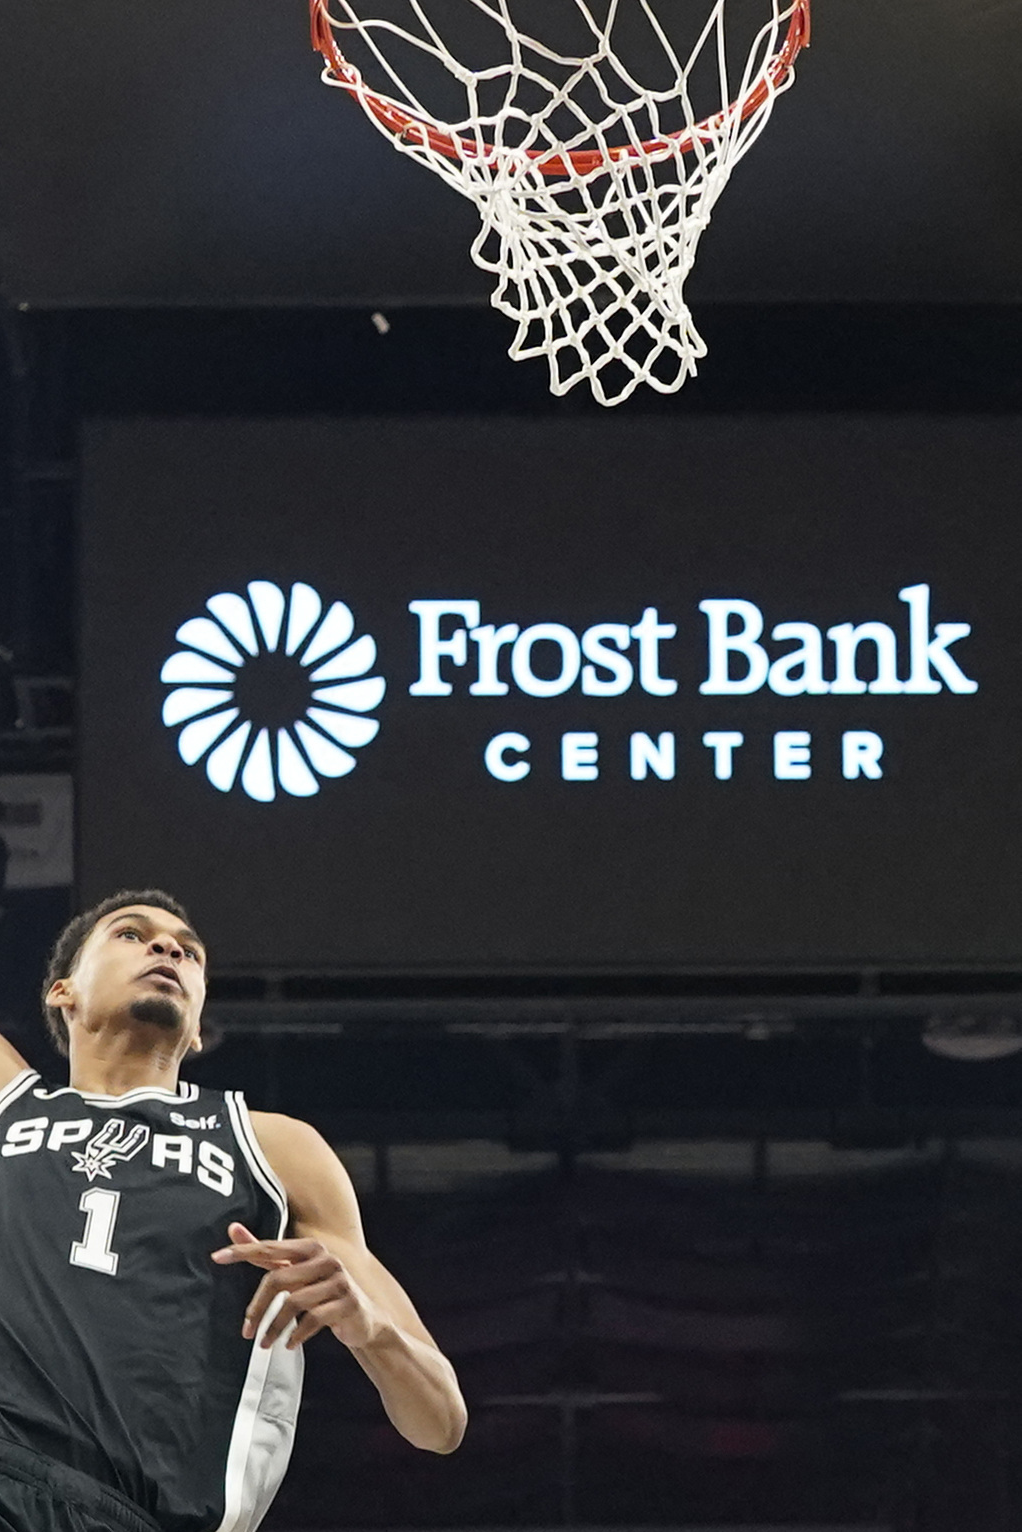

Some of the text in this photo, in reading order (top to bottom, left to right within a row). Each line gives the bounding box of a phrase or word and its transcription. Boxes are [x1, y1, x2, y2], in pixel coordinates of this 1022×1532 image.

[409, 583, 979, 698] Frost Bank
[485, 731, 885, 782] CENTER
[1, 1115, 235, 1198] SPURS
[69, 1187, 121, 1276] 1
